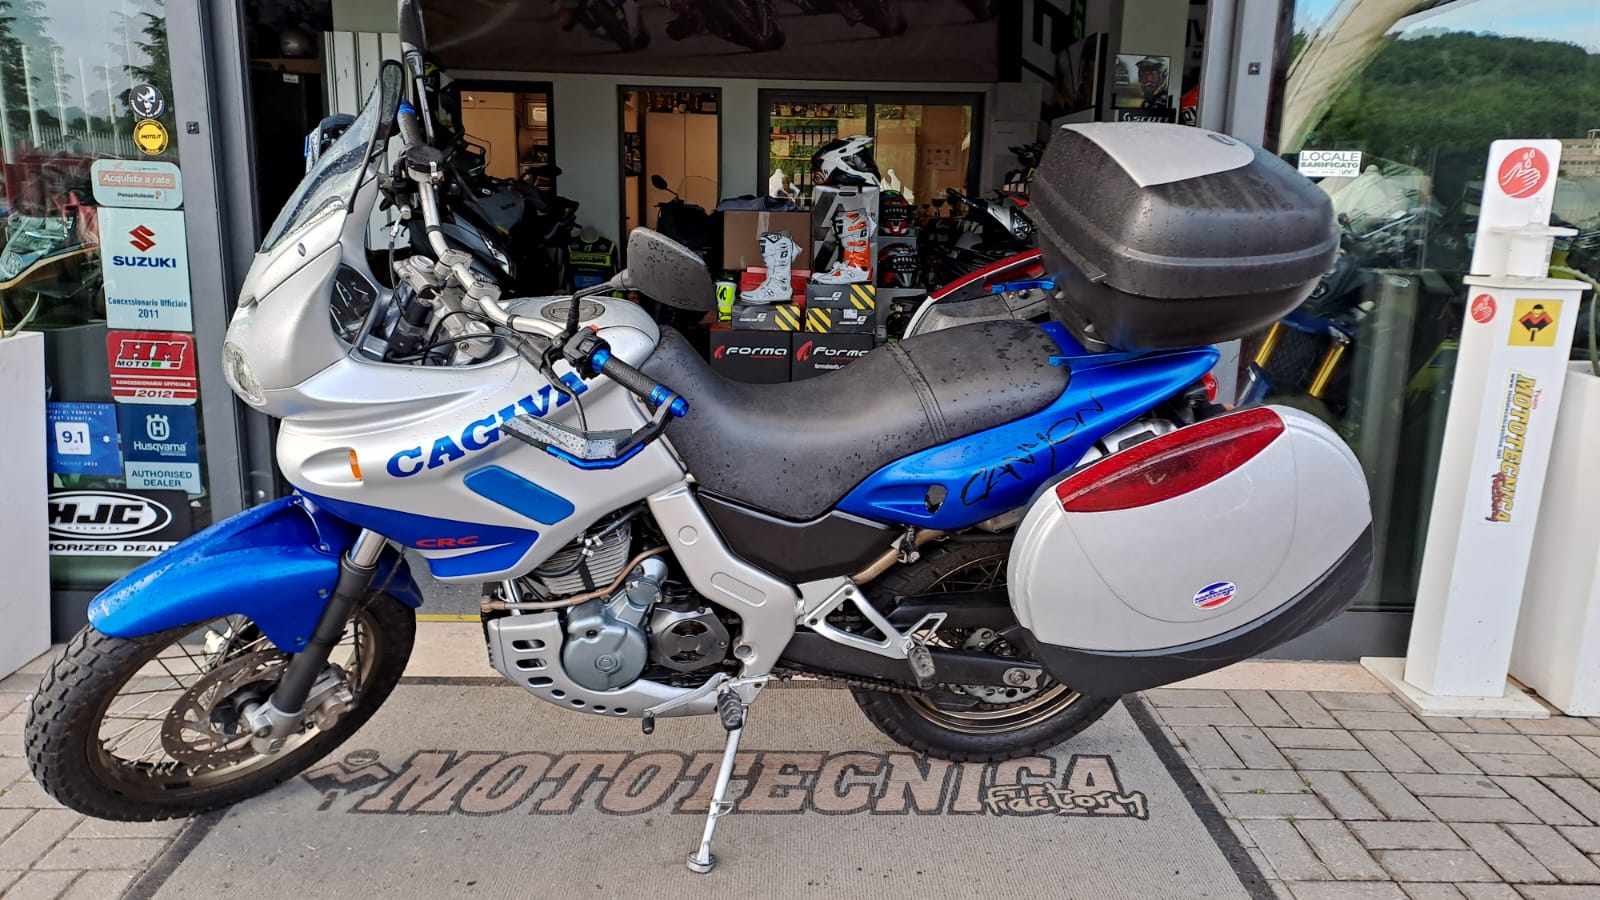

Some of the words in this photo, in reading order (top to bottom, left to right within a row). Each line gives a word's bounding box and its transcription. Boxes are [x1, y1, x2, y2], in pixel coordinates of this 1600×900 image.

[1301, 152, 1360, 162] LOCALE
[103, 174, 143, 184] Acquista
[152, 176, 171, 184] rate
[113, 255, 177, 268] SUZUKI
[107, 297, 159, 307] Concessionario
[160, 299, 188, 308] Ufficiale
[138, 309, 159, 319] 2011
[118, 341, 187, 361] HM
[136, 390, 173, 398] 2012
[1531, 389, 1543, 410] Team
[386, 371, 588, 478] CAGIVA
[62, 430, 84, 444] 9.1
[133, 441, 187, 453] Husqvarna
[1497, 375, 1536, 522] MOTOTECNICA
[131, 469, 193, 479] AUTHORISED
[143, 479, 182, 487] DEALER
[49, 503, 144, 525] HJC
[50, 543, 118, 552] ORIZED
[122, 544, 175, 553] DEAL
[415, 535, 480, 548] CRC
[348, 750, 1122, 816] MOTOTECNICA
[983, 782, 1149, 820] Factory
